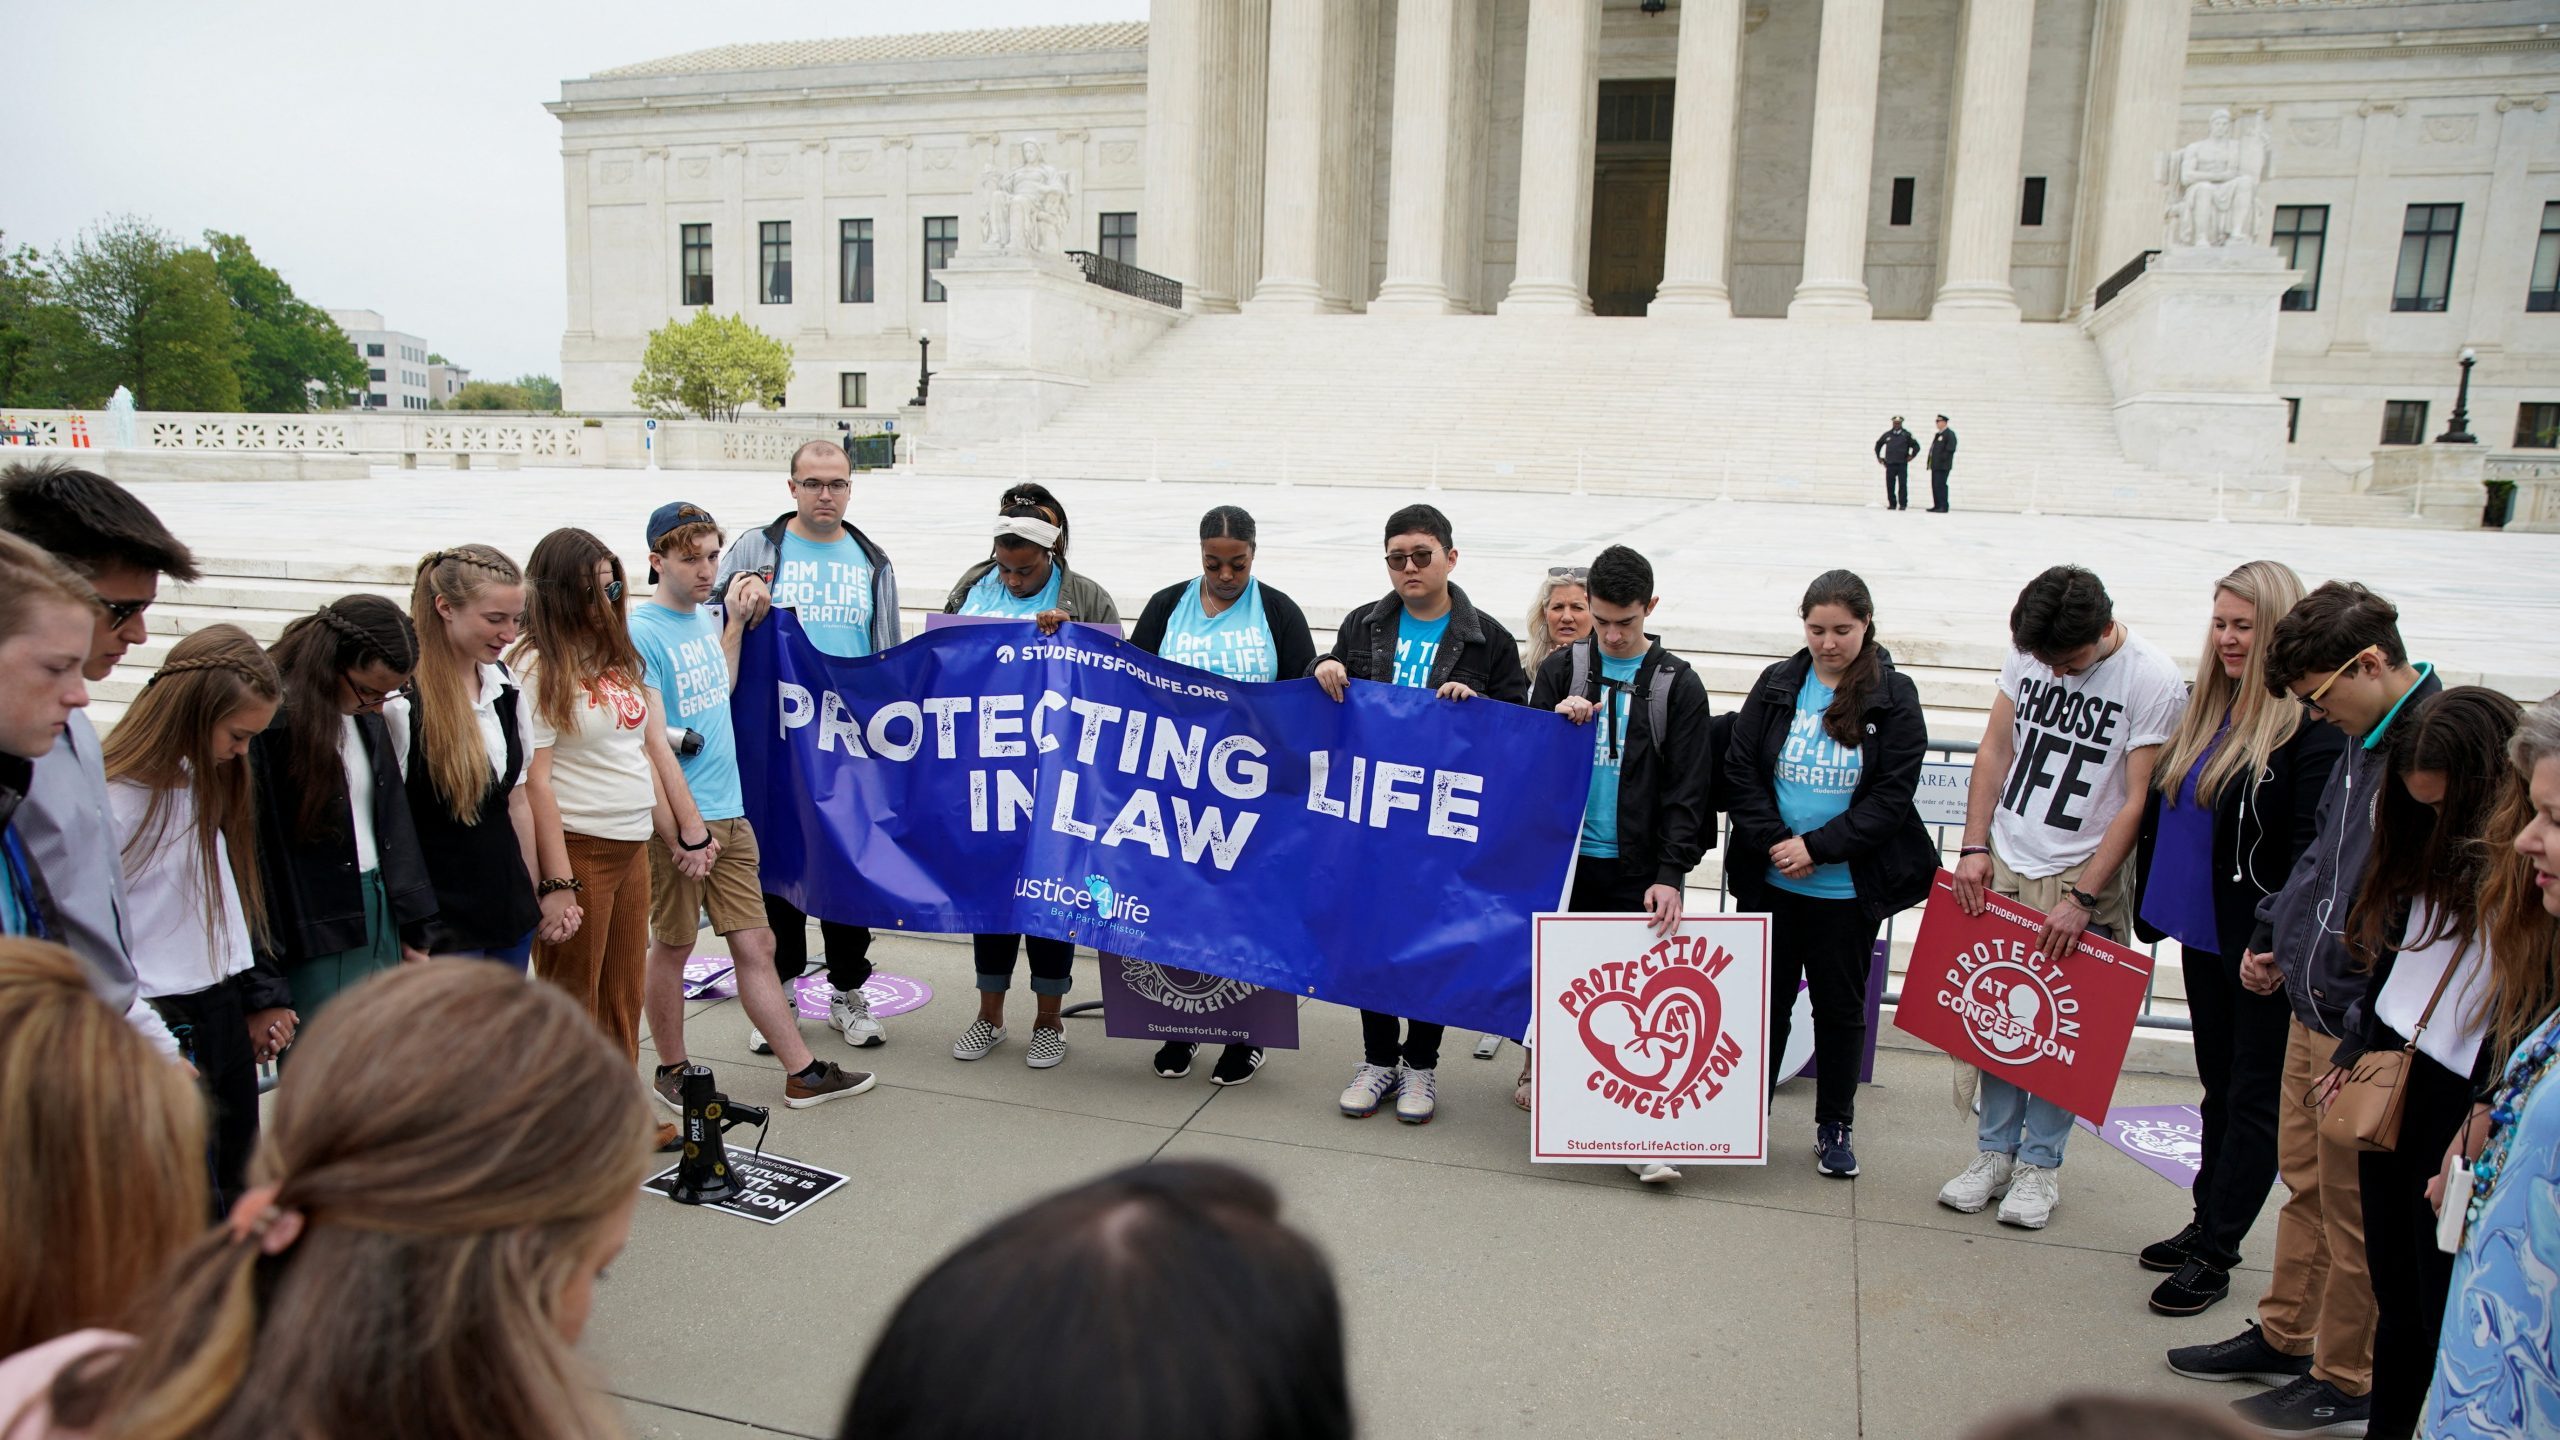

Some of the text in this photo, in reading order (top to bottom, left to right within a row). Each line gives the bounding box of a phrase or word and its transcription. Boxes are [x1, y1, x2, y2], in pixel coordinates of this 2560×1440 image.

[783, 561, 867, 589] AM THE
[800, 605, 869, 627] ERATION
[1176, 632, 1212, 652] AM
[1220, 626, 1266, 649] THE
[667, 647, 680, 672] I
[680, 638, 708, 669] AM
[675, 658, 730, 698] PRO-LI
[1021, 644, 1229, 702] STUDENTSFORLIFE.ORG
[2015, 676, 2124, 746] CHOOSE
[777, 679, 1484, 843] PROTECTING LIFE
[1919, 774, 1958, 788] AREA
[1051, 770, 1261, 872] LAW
[1050, 907, 1147, 938] Be A Part of History
[1558, 935, 1735, 1019] PROTECTION
[1945, 938, 2081, 1038] PROTECTION
[1978, 976, 2009, 998] AT
[1147, 1023, 1250, 1040] StudentsforLife.org
[1664, 1005, 1690, 1033] AT
[1936, 989, 2076, 1066] CONCEPTION
[1586, 1031, 1744, 1120] CONCEPTION
[691, 1119, 701, 1142] PYLE
[1567, 1139, 1731, 1154] StudentsforLifeAction.org
[735, 1163, 799, 1185] FUTURE
[797, 1181, 818, 1190] IS
[732, 1188, 797, 1212] TION
